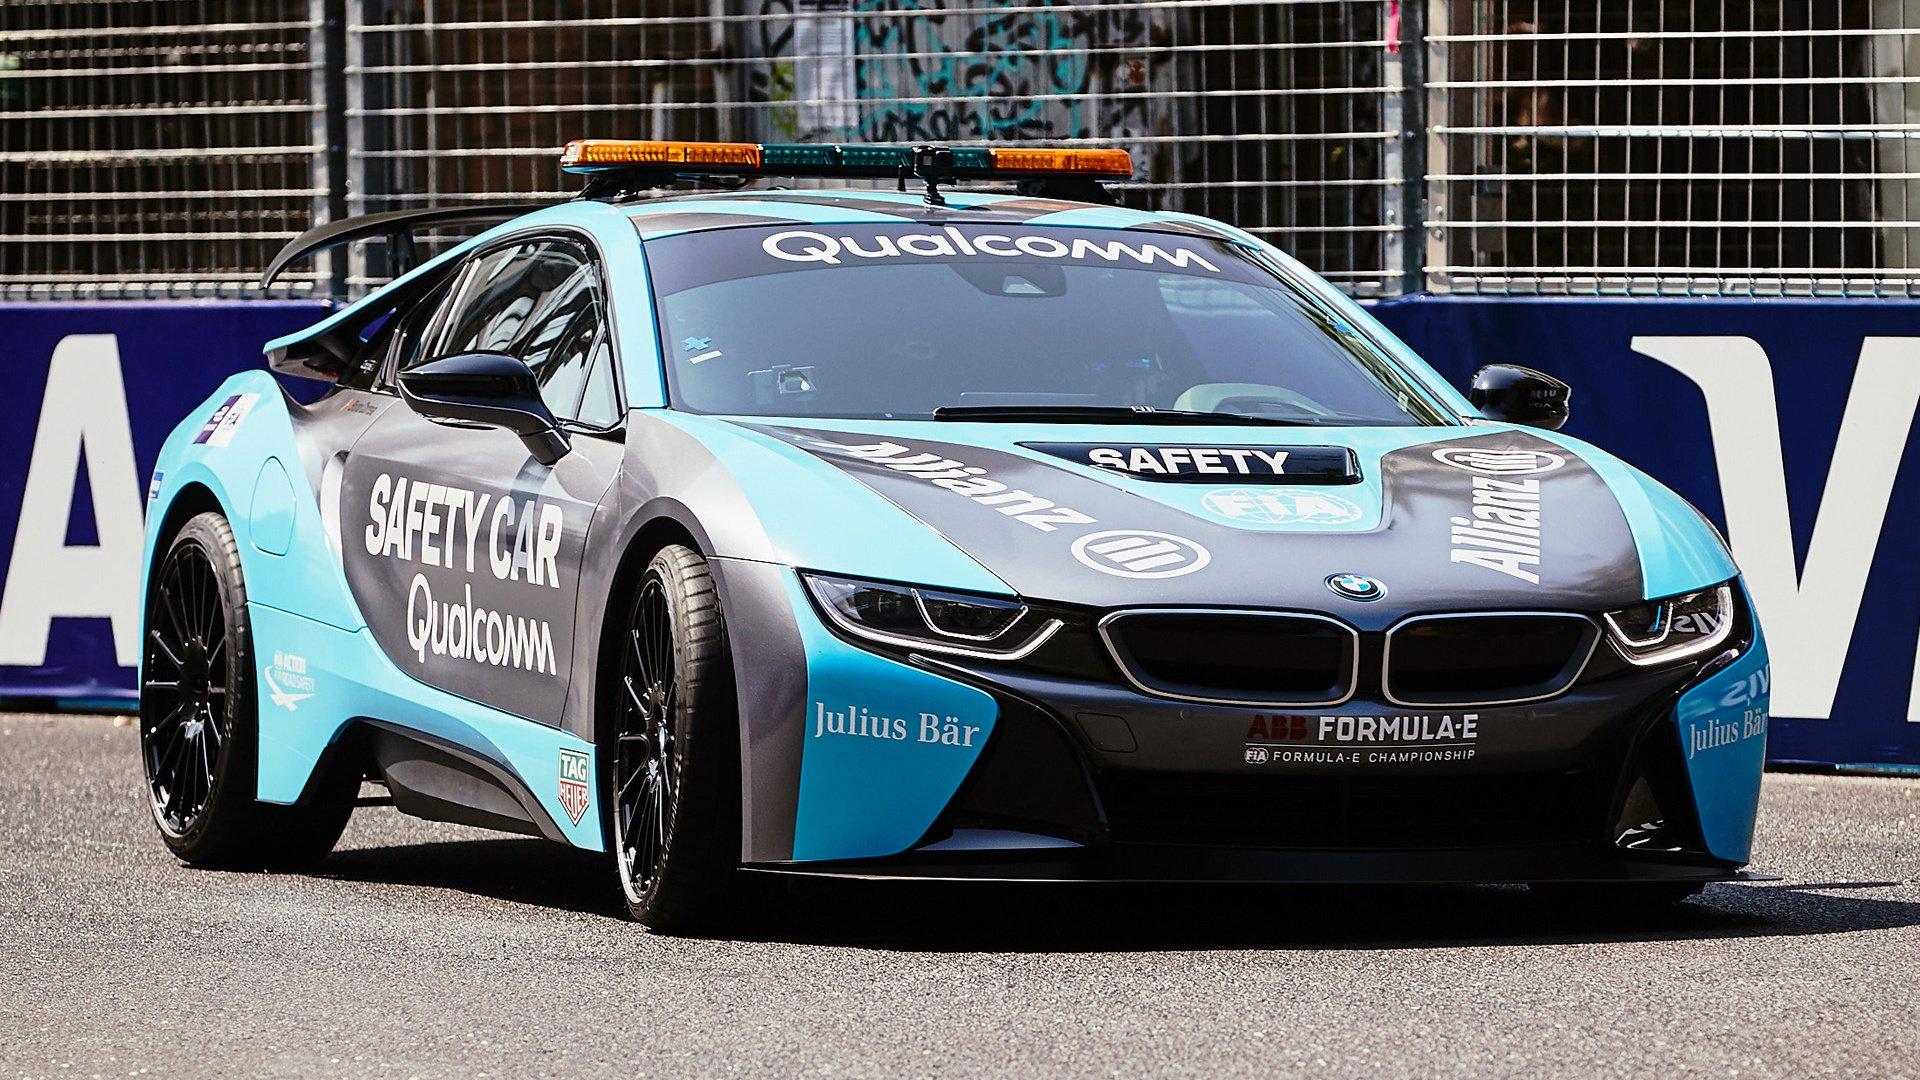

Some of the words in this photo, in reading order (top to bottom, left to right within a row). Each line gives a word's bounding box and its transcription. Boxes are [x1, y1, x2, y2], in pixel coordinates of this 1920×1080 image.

[762, 227, 1221, 272] Qualcomm
[1088, 448, 1290, 475] SAFETY
[0, 333, 146, 667] A
[808, 441, 1098, 531] Allianz
[1208, 494, 1349, 518] FIA
[365, 473, 491, 573] SAFETY
[489, 495, 560, 589] CAR
[1450, 475, 1540, 585] Allianz
[1630, 336, 1920, 720] V
[407, 572, 557, 676] Qualcomm
[815, 702, 907, 741] Julius
[917, 712, 980, 748] Bär
[1247, 714, 1308, 740] ABB
[1688, 719, 1739, 760] Julius
[1742, 708, 1768, 740] Bär
[561, 753, 588, 781] TAG
[1273, 751, 1360, 763] FORMULA-E
[1368, 749, 1476, 763] CHAMPIONSHIP
[560, 782, 588, 820] HEUER
